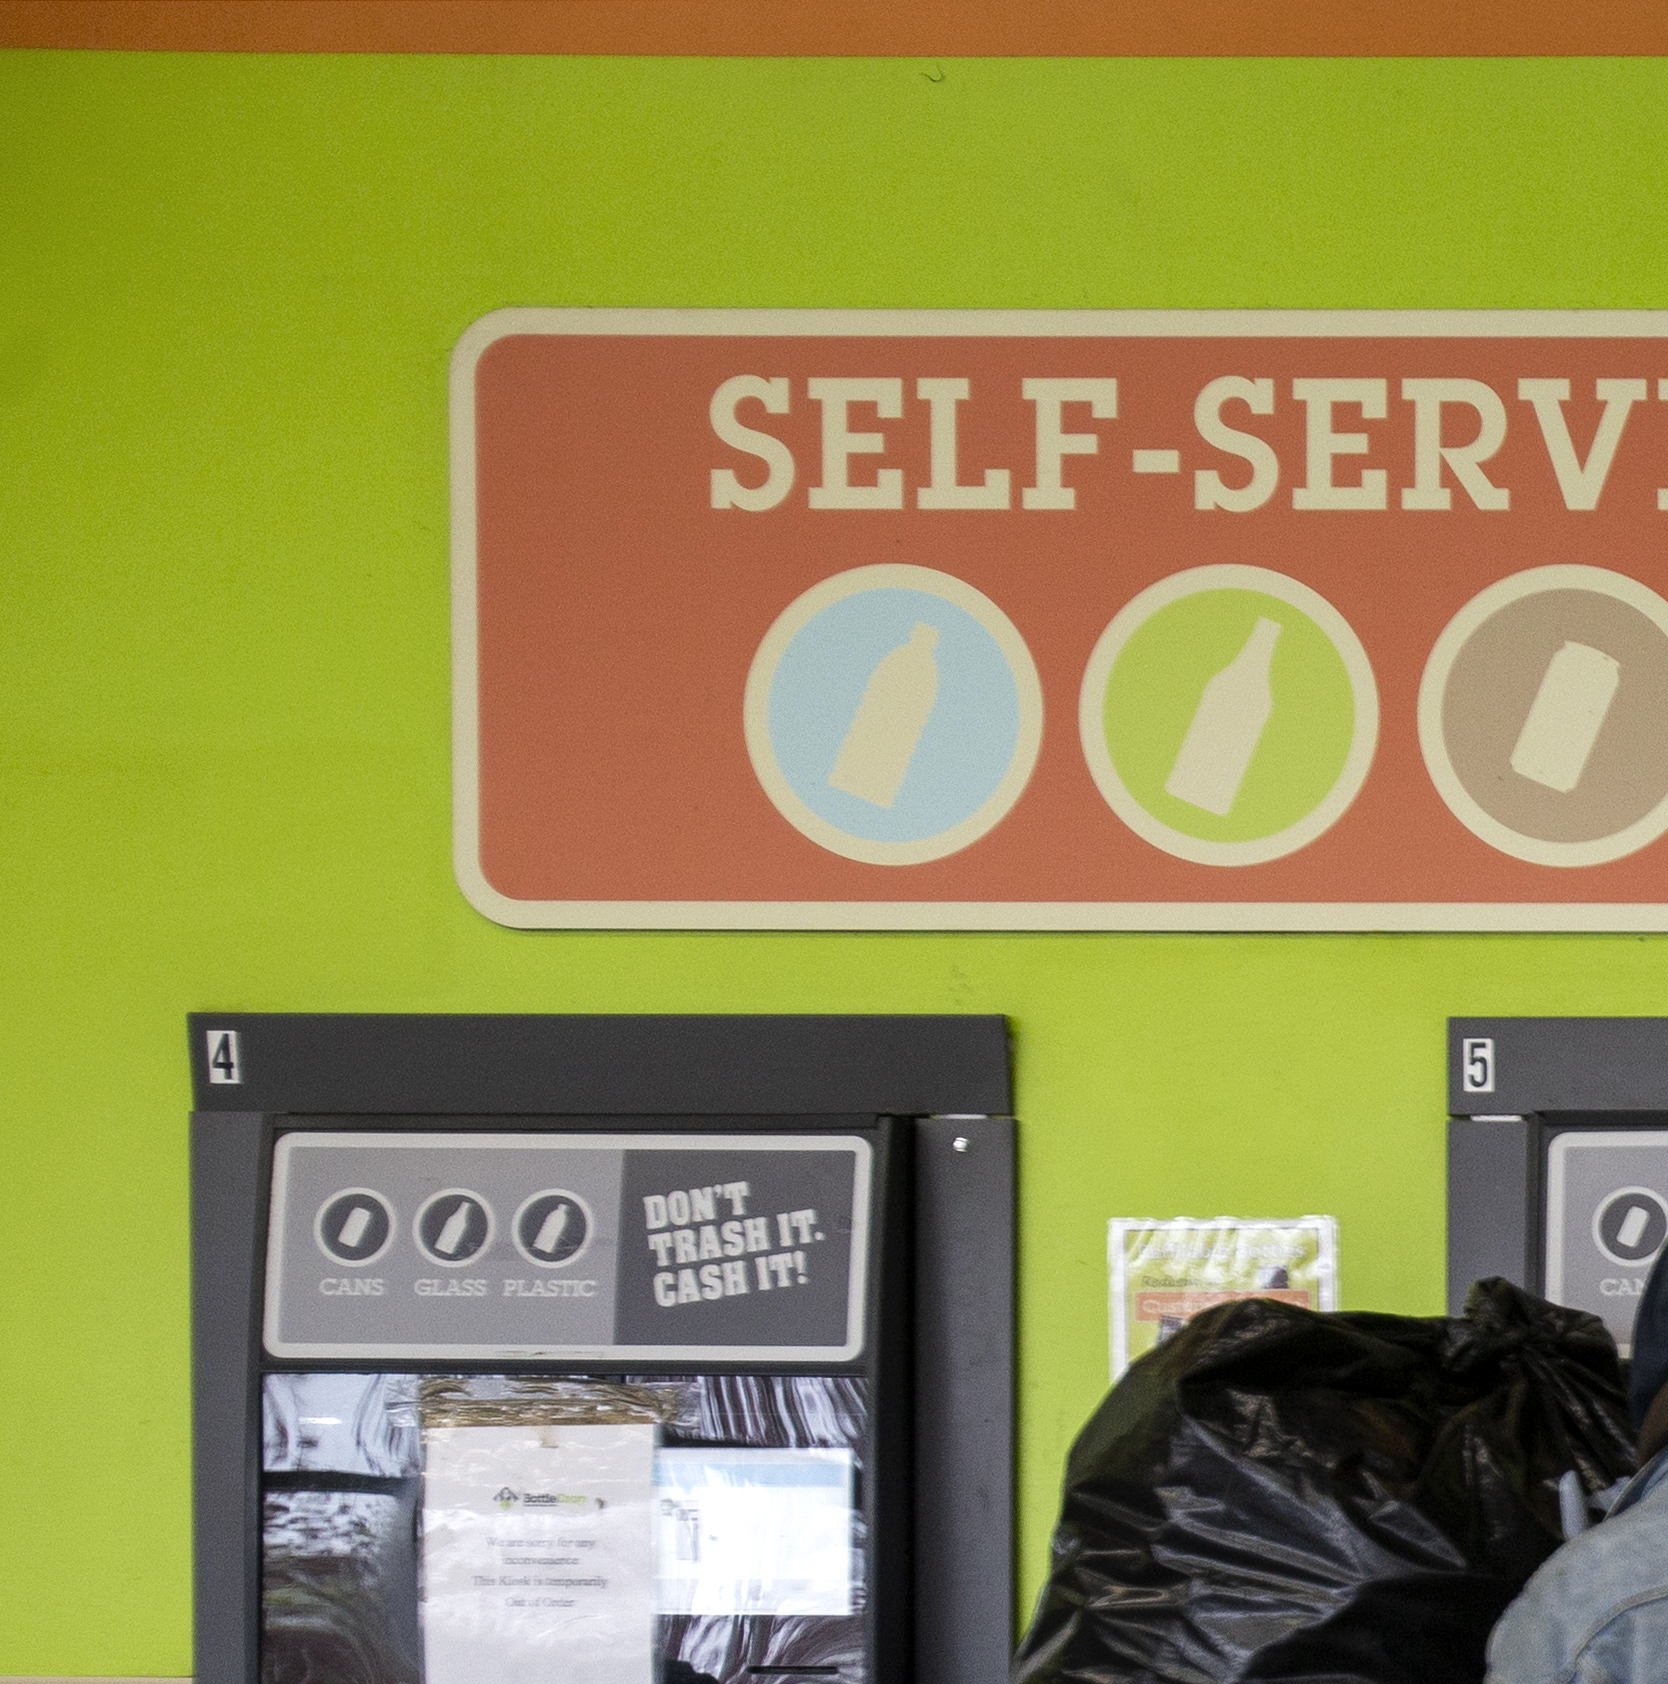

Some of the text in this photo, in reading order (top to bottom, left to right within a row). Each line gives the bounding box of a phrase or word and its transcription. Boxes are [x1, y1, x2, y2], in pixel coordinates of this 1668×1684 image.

[212, 1033, 235, 1080] 4
[1467, 1041, 1488, 1088] 5
[642, 1180, 750, 1231] DON'T
[647, 1208, 827, 1268] TRASH IT.
[319, 1277, 598, 1298] CANS GLASS PLASTIC
[652, 1249, 809, 1308] CASH IT!
[1600, 1277, 1646, 1296] CAN
